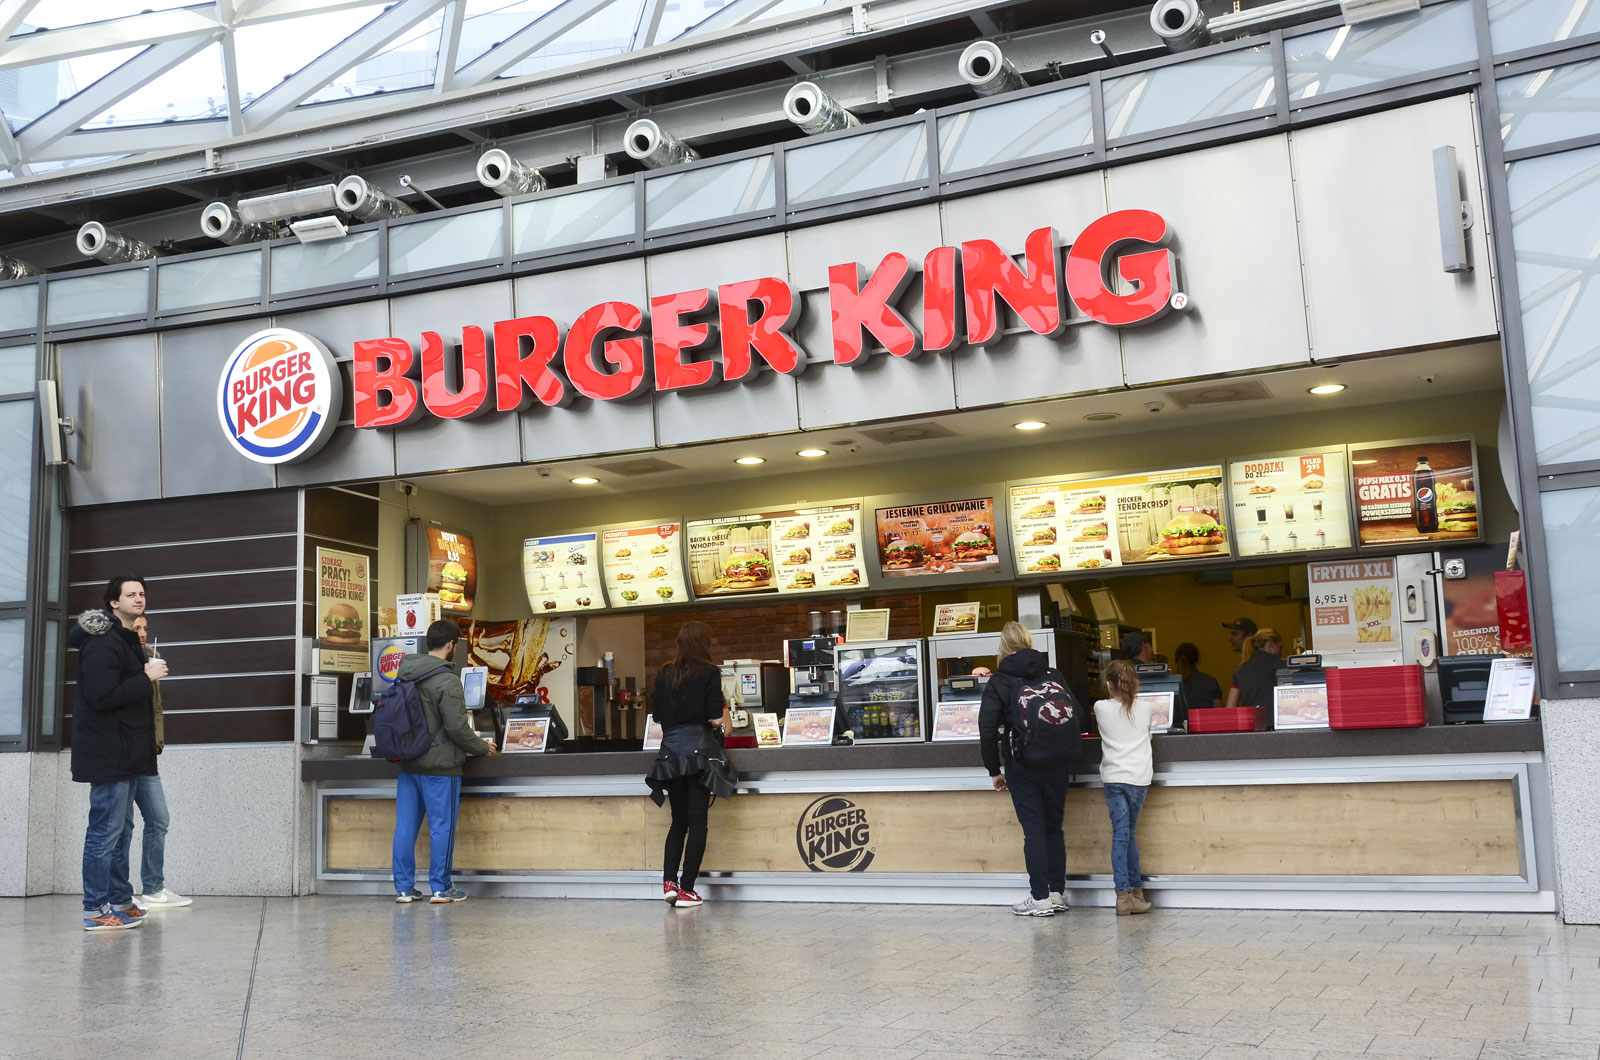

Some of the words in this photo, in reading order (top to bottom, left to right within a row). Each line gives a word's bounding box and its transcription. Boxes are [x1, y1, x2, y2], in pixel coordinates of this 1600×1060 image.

[353, 276, 803, 430] BURGER
[828, 209, 1175, 365] KING
[232, 351, 312, 401] BURGER
[236, 373, 316, 436] KING
[1244, 461, 1284, 473] DODATKI
[1359, 477, 1378, 485] PEPSI
[1379, 476, 1394, 484] MAX
[1359, 483, 1411, 500] GRATIS
[885, 506, 924, 519] JESIENNE
[927, 501, 985, 515] GRILLOWANIE
[1118, 500, 1169, 511] TENDERCRISP
[437, 538, 449, 550] BIG
[450, 541, 466, 555] KING
[321, 557, 343, 567] SZUKASZ
[322, 566, 351, 582] PRACY?
[1313, 564, 1360, 581] FRYTKI
[1363, 563, 1391, 577] XXL
[321, 587, 347, 599] BURGER
[349, 590, 365, 601] KING!
[1315, 595, 1336, 605] 6,95
[1338, 594, 1348, 603] zł
[1330, 616, 1335, 624] 2
[1456, 635, 1492, 650] 100%
[380, 660, 400, 674] KIN
[805, 809, 867, 841] BURGER
[809, 824, 869, 864] KING
